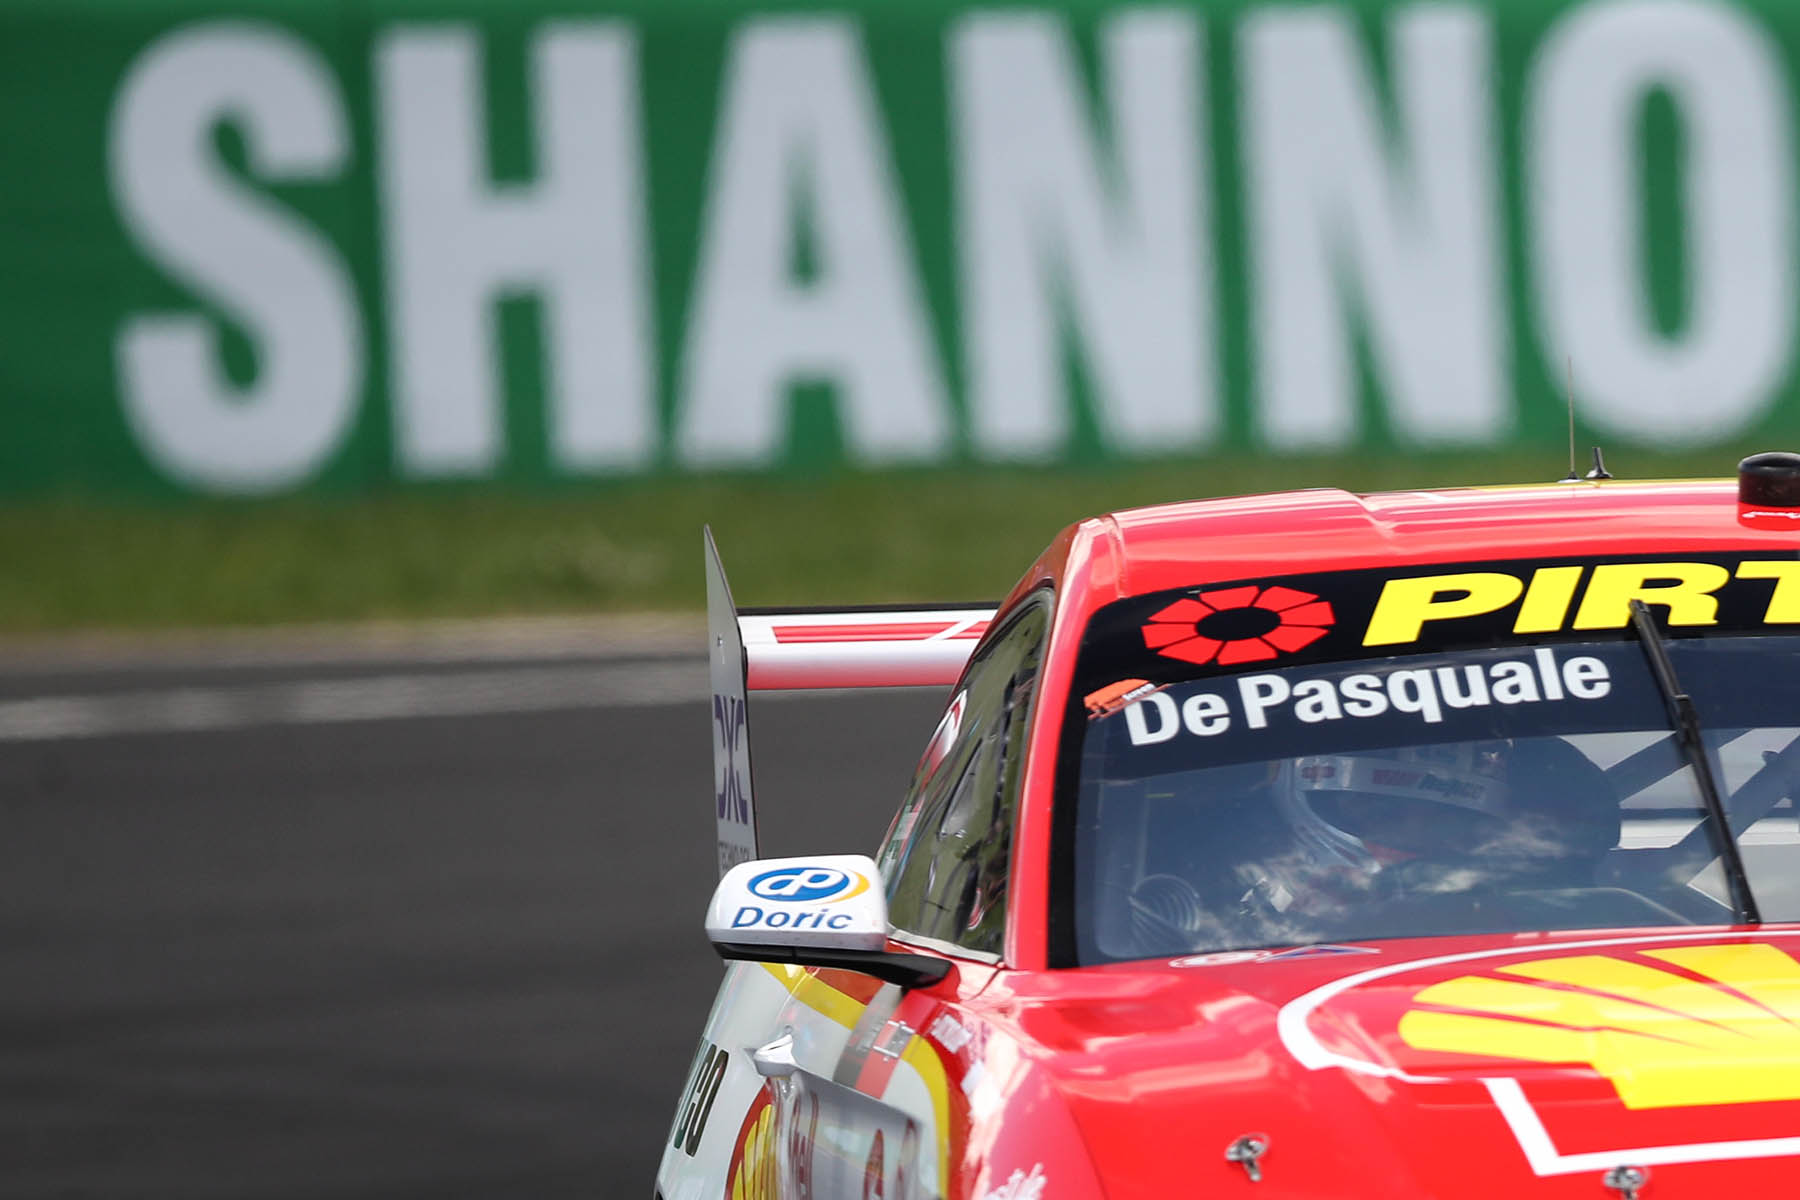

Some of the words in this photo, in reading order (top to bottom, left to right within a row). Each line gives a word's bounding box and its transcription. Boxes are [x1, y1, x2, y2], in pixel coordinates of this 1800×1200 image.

[1124, 692, 1230, 747] De
[1238, 648, 1612, 729] Pasquale
[731, 905, 852, 930] Doric
